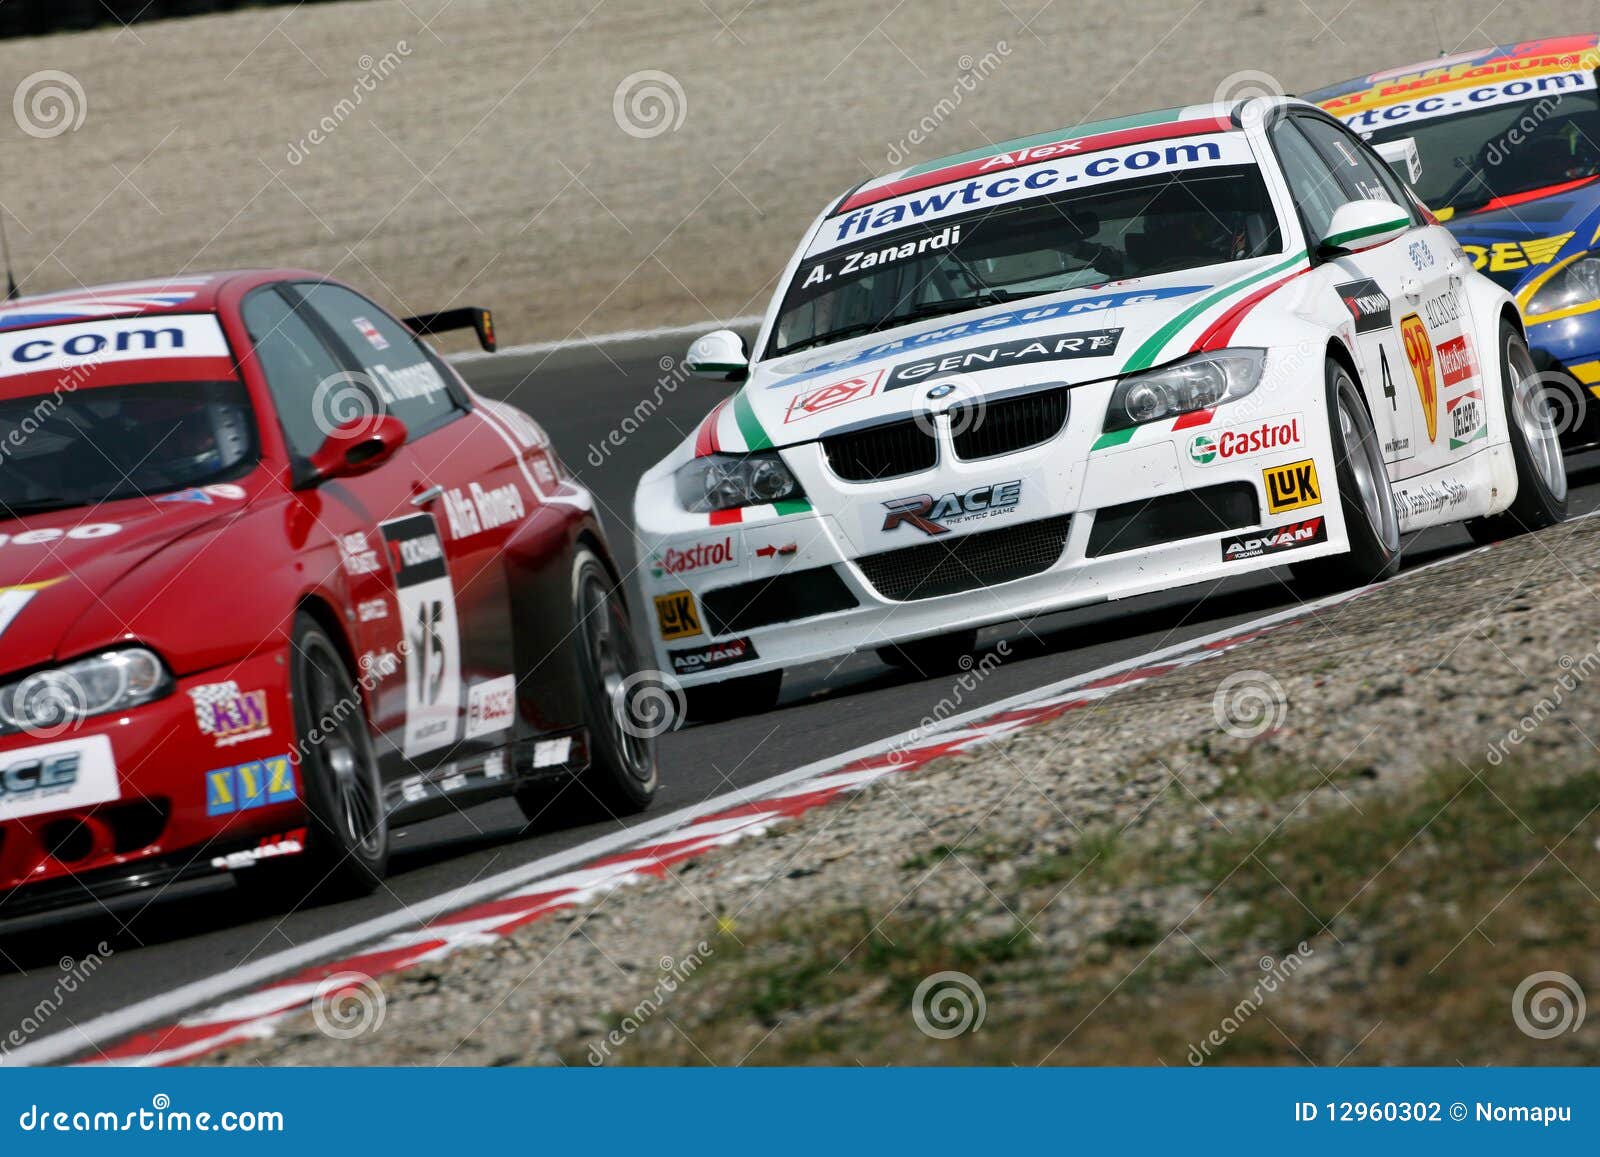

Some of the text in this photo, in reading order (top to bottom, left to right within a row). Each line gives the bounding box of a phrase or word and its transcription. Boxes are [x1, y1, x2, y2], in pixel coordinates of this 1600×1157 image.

[1380, 54, 1581, 96] BELGIUM
[979, 140, 1082, 171] Alex
[835, 138, 1220, 241] fiawtcc.com
[801, 225, 961, 289] A. Zanardi
[896, 335, 1109, 381] GEN-ART
[1379, 343, 1397, 411] 4
[1219, 418, 1300, 459] Castrol
[881, 479, 1022, 536] RACE
[946, 506, 1016, 526] THE WTCC GAME
[664, 536, 733, 575] Castrol
[1226, 527, 1313, 554] ADVAN
[675, 646, 743, 667] ADVAN
[210, 759, 291, 806] XYZ
